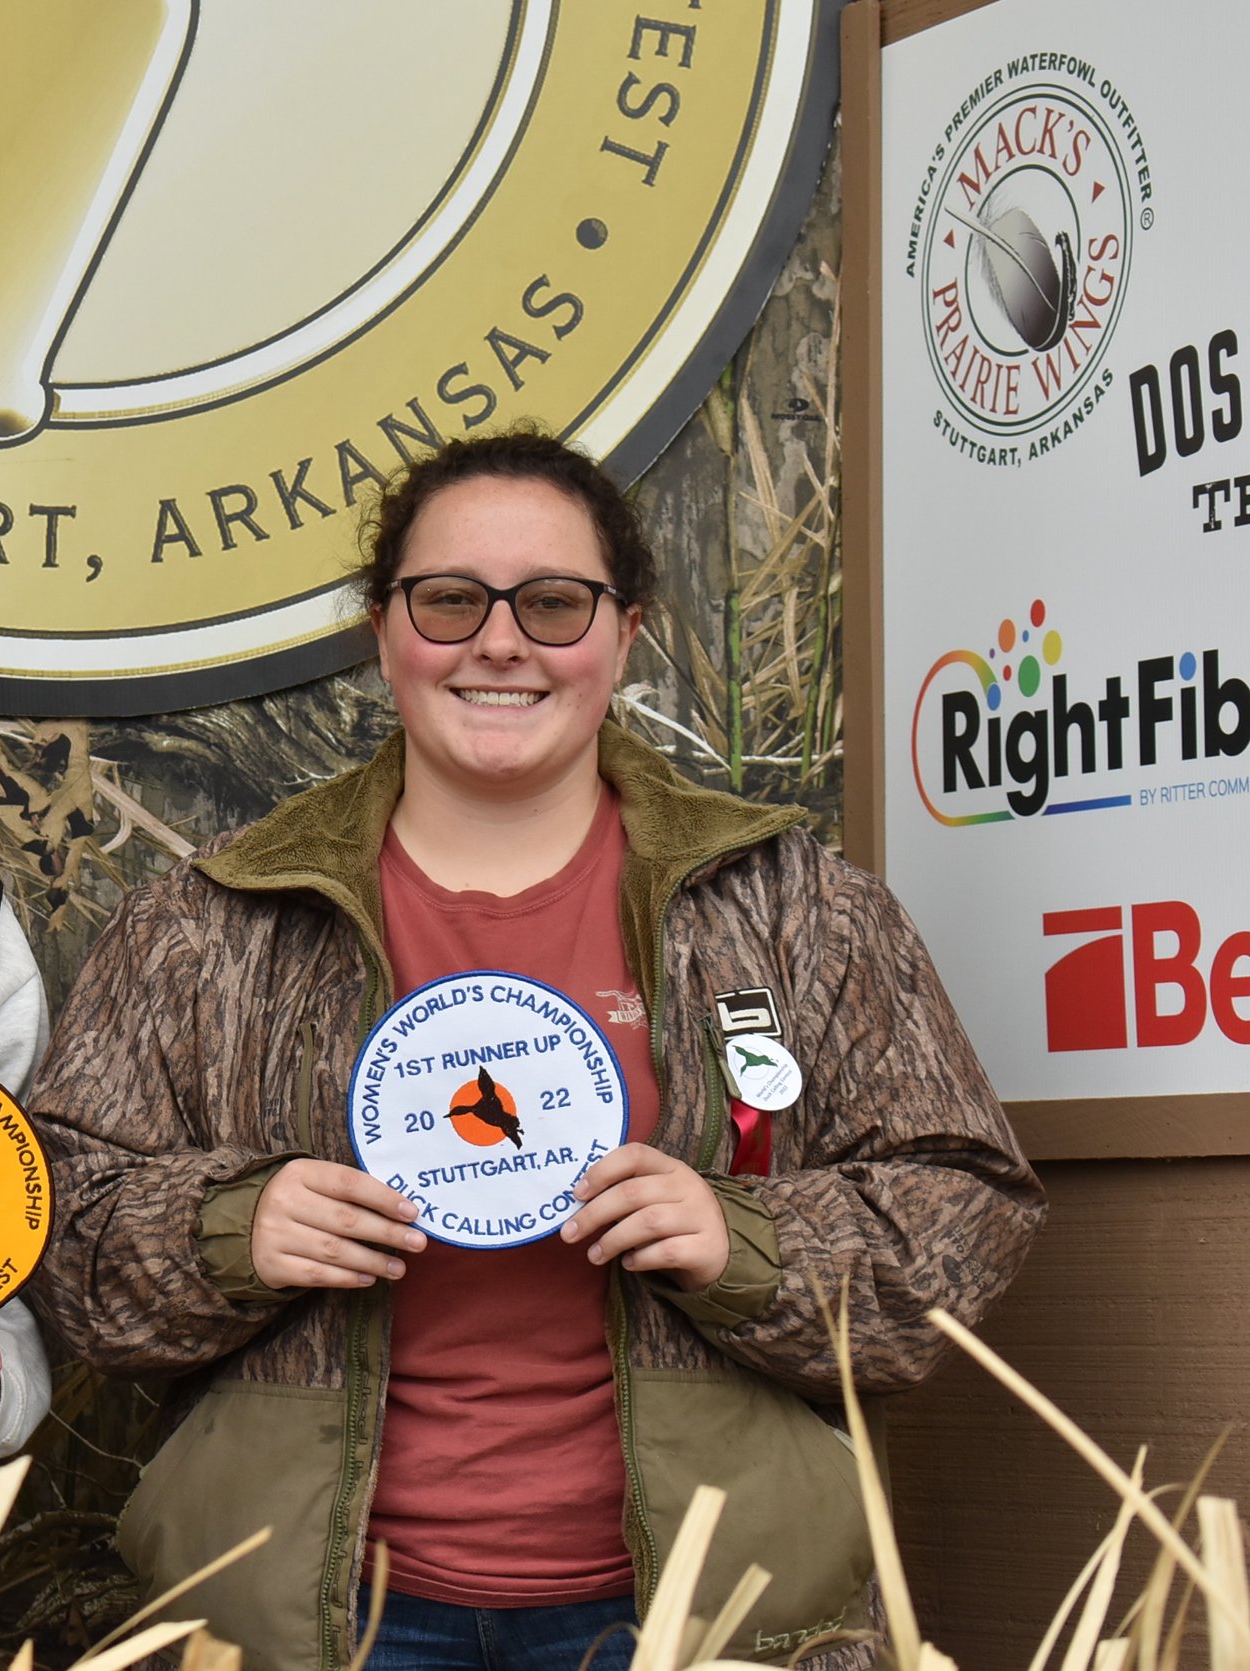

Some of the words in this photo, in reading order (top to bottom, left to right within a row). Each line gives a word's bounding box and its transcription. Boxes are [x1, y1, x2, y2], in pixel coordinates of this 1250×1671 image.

[600, 0, 701, 187] EST
[906, 143, 945, 277] AMERICA'S
[944, 69, 1004, 143] PREMIER
[1007, 52, 1096, 87] WATERFOWL
[957, 105, 1091, 212] MACK'S
[932, 277, 1021, 415] PRAIRIE
[1031, 233, 1120, 401] WINGS
[151, 274, 584, 562] ARKANSAS
[933, 410, 1022, 468] STUTTGART,
[1028, 368, 1113, 461] ARKANSAS
[1129, 329, 1242, 477] DOS
[942, 649, 1250, 817] RightFib
[1140, 789, 1157, 806] BY
[1160, 782, 1206, 804] RITTER
[1209, 776, 1250, 798] COMM
[361, 1037, 398, 1144] WOMEN'S
[393, 985, 484, 1037] WORLD'S
[490, 984, 614, 1104] CHAMPIONSHIP
[394, 1056, 435, 1079] 1ST
[442, 1039, 529, 1070] RUNNER
[534, 1033, 562, 1053] UP
[404, 1110, 435, 1133] 20
[539, 1087, 571, 1111] 22
[417, 1152, 541, 1188] STUTTGART,
[543, 1146, 578, 1167] AR.
[442, 1212, 537, 1236] CALLING
